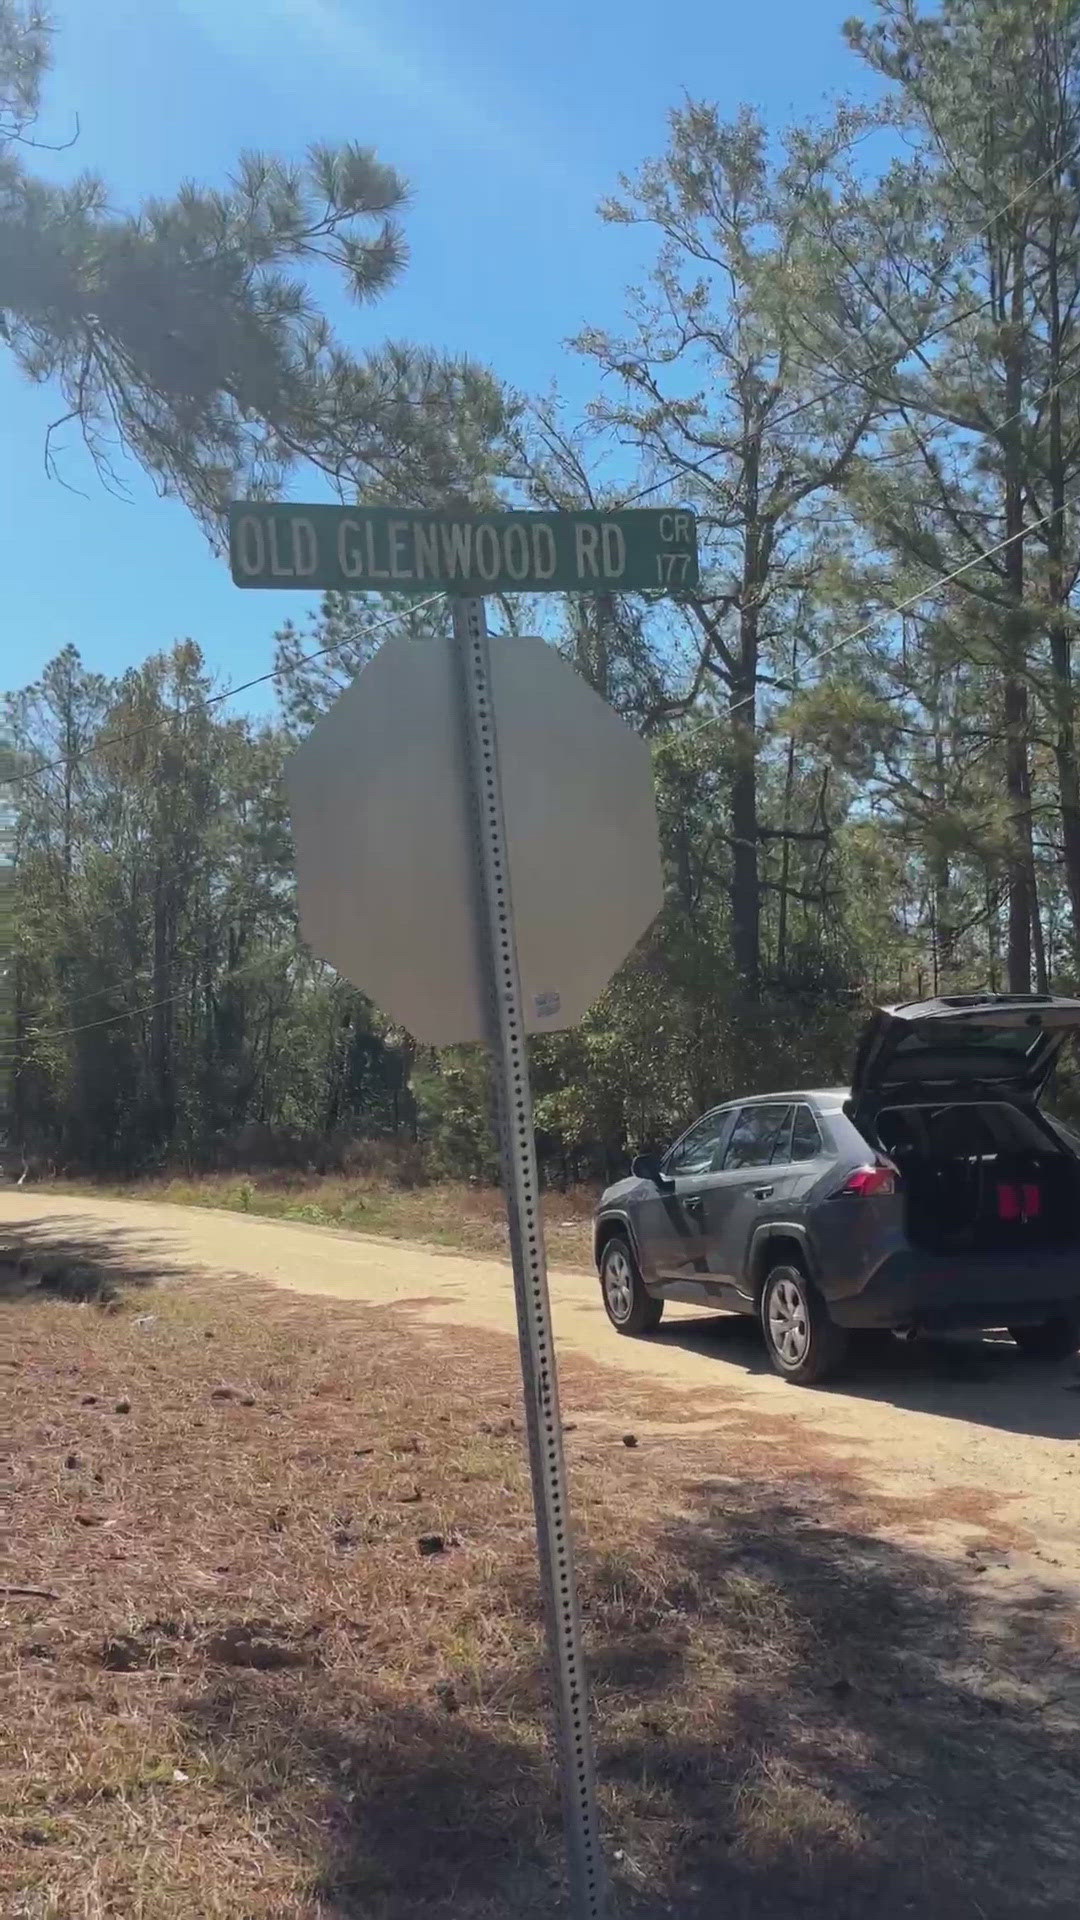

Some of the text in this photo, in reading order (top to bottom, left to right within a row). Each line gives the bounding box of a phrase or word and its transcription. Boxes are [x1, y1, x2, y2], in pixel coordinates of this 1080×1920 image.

[659, 514, 691, 543] CR
[238, 515, 626, 581] OLD GLENWOOD RD
[656, 553, 691, 582] 177
